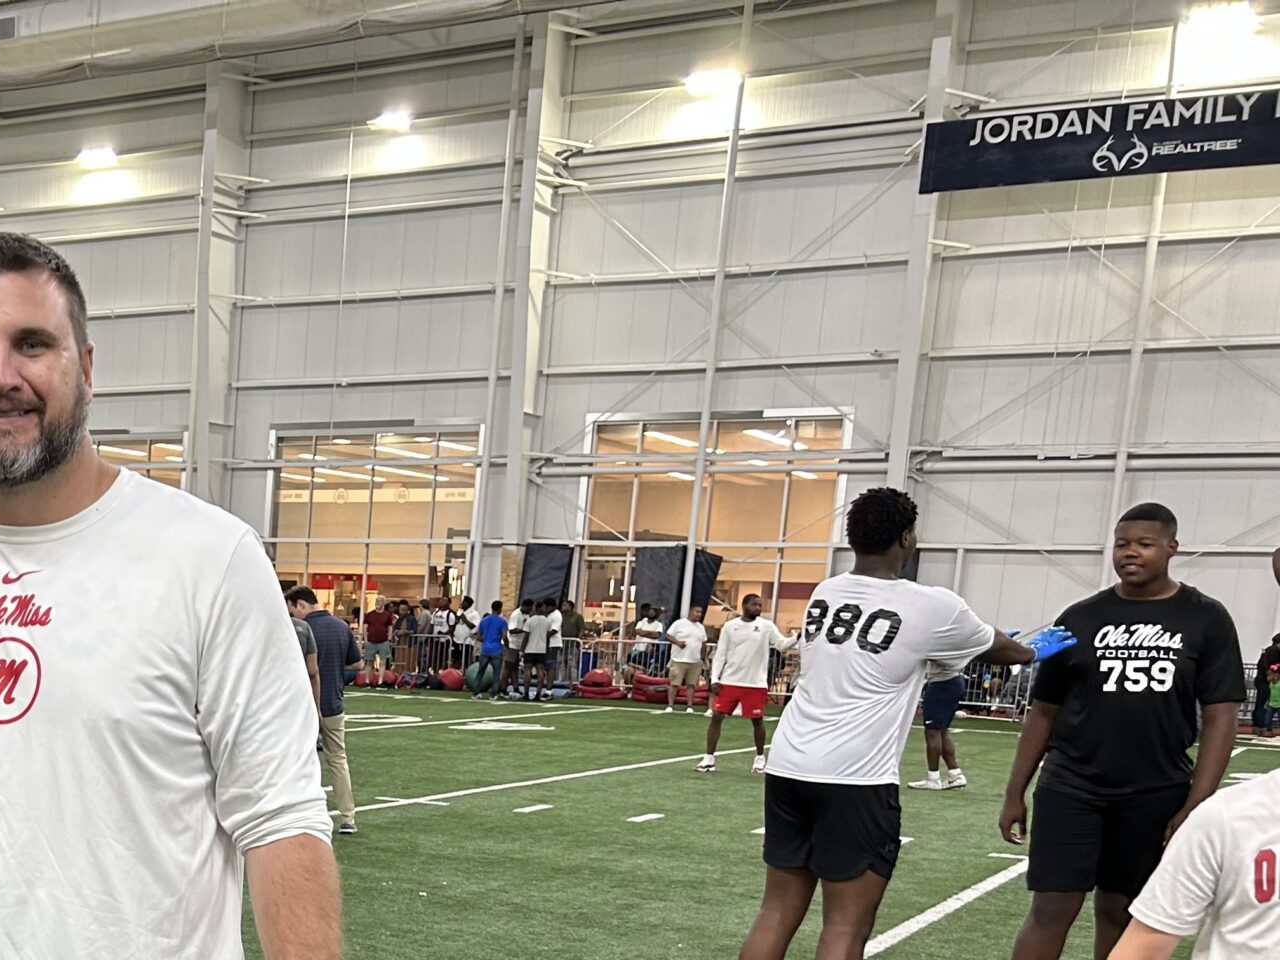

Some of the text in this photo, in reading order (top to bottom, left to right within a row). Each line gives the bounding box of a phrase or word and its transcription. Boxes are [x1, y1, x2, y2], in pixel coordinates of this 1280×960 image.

[969, 106, 1112, 146] JORDAN
[1125, 92, 1261, 131] FAMILY
[1150, 139, 1239, 156] REALTREE
[4, 594, 53, 628] Miss
[804, 599, 903, 655] 880
[1093, 623, 1183, 650] Ole Miss
[1096, 649, 1178, 660] FOOTBALL
[1099, 659, 1176, 692] 759
